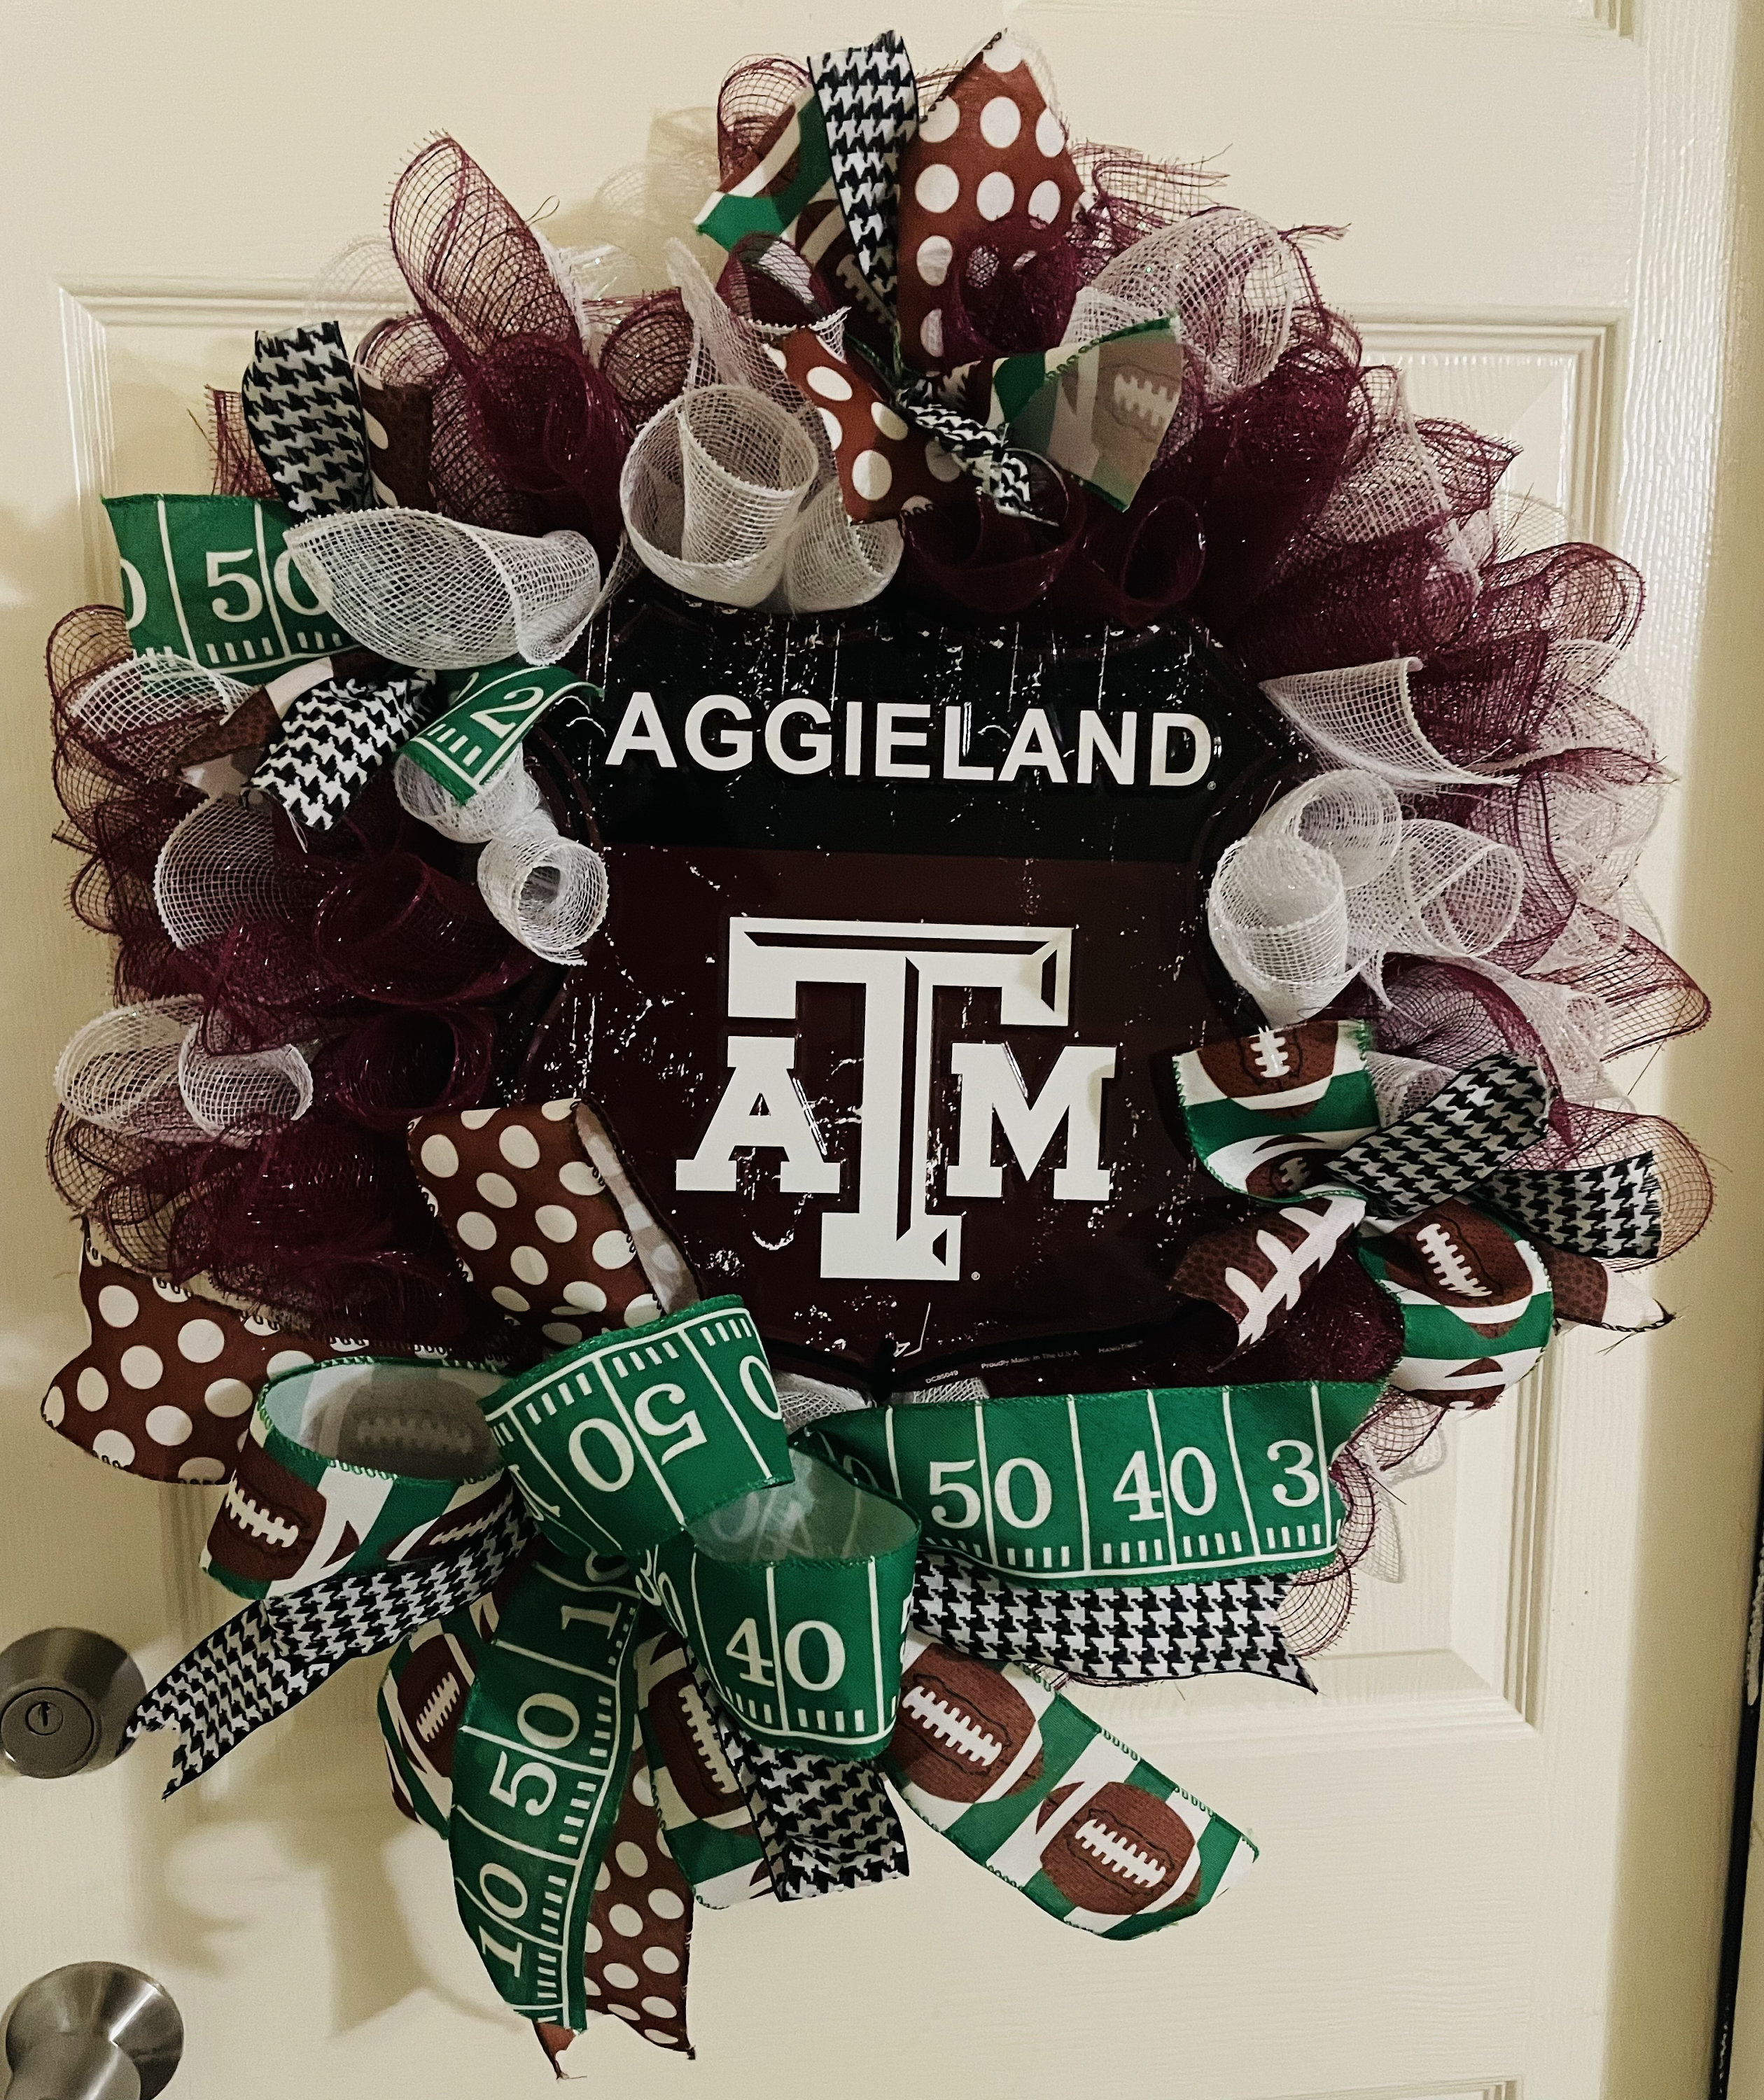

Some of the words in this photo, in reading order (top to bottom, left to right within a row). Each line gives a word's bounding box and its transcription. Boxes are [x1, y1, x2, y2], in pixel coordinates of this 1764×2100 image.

[605, 690, 1212, 787] AGGIELAND
[928, 1456, 1051, 1529] 50
[1113, 1446, 1217, 1521] 40
[726, 1618, 846, 1691] 40
[489, 1693, 580, 1816] 50
[479, 1862, 528, 1978] 10
